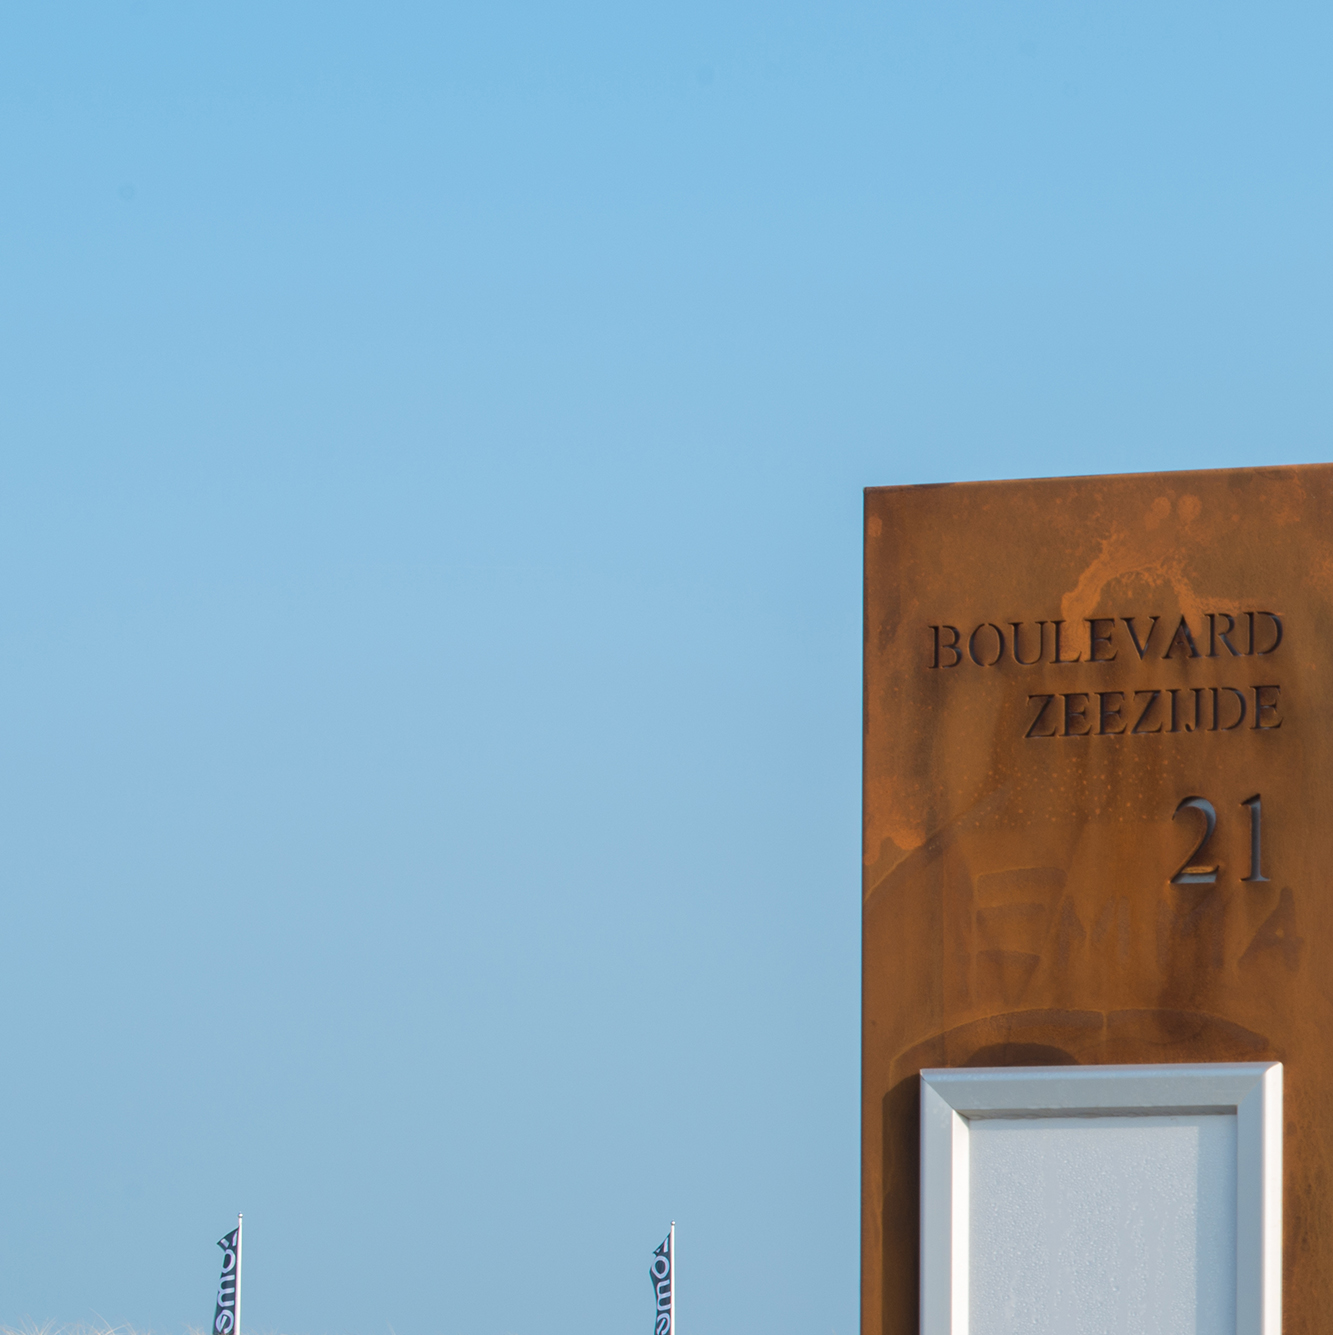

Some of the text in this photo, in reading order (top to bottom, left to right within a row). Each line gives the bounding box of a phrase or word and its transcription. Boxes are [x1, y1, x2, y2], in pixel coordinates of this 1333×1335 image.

[927, 611, 1284, 669] BOULEVARD
[1024, 685, 1284, 738] ZEEZIJDE
[1169, 793, 1271, 884] 21
